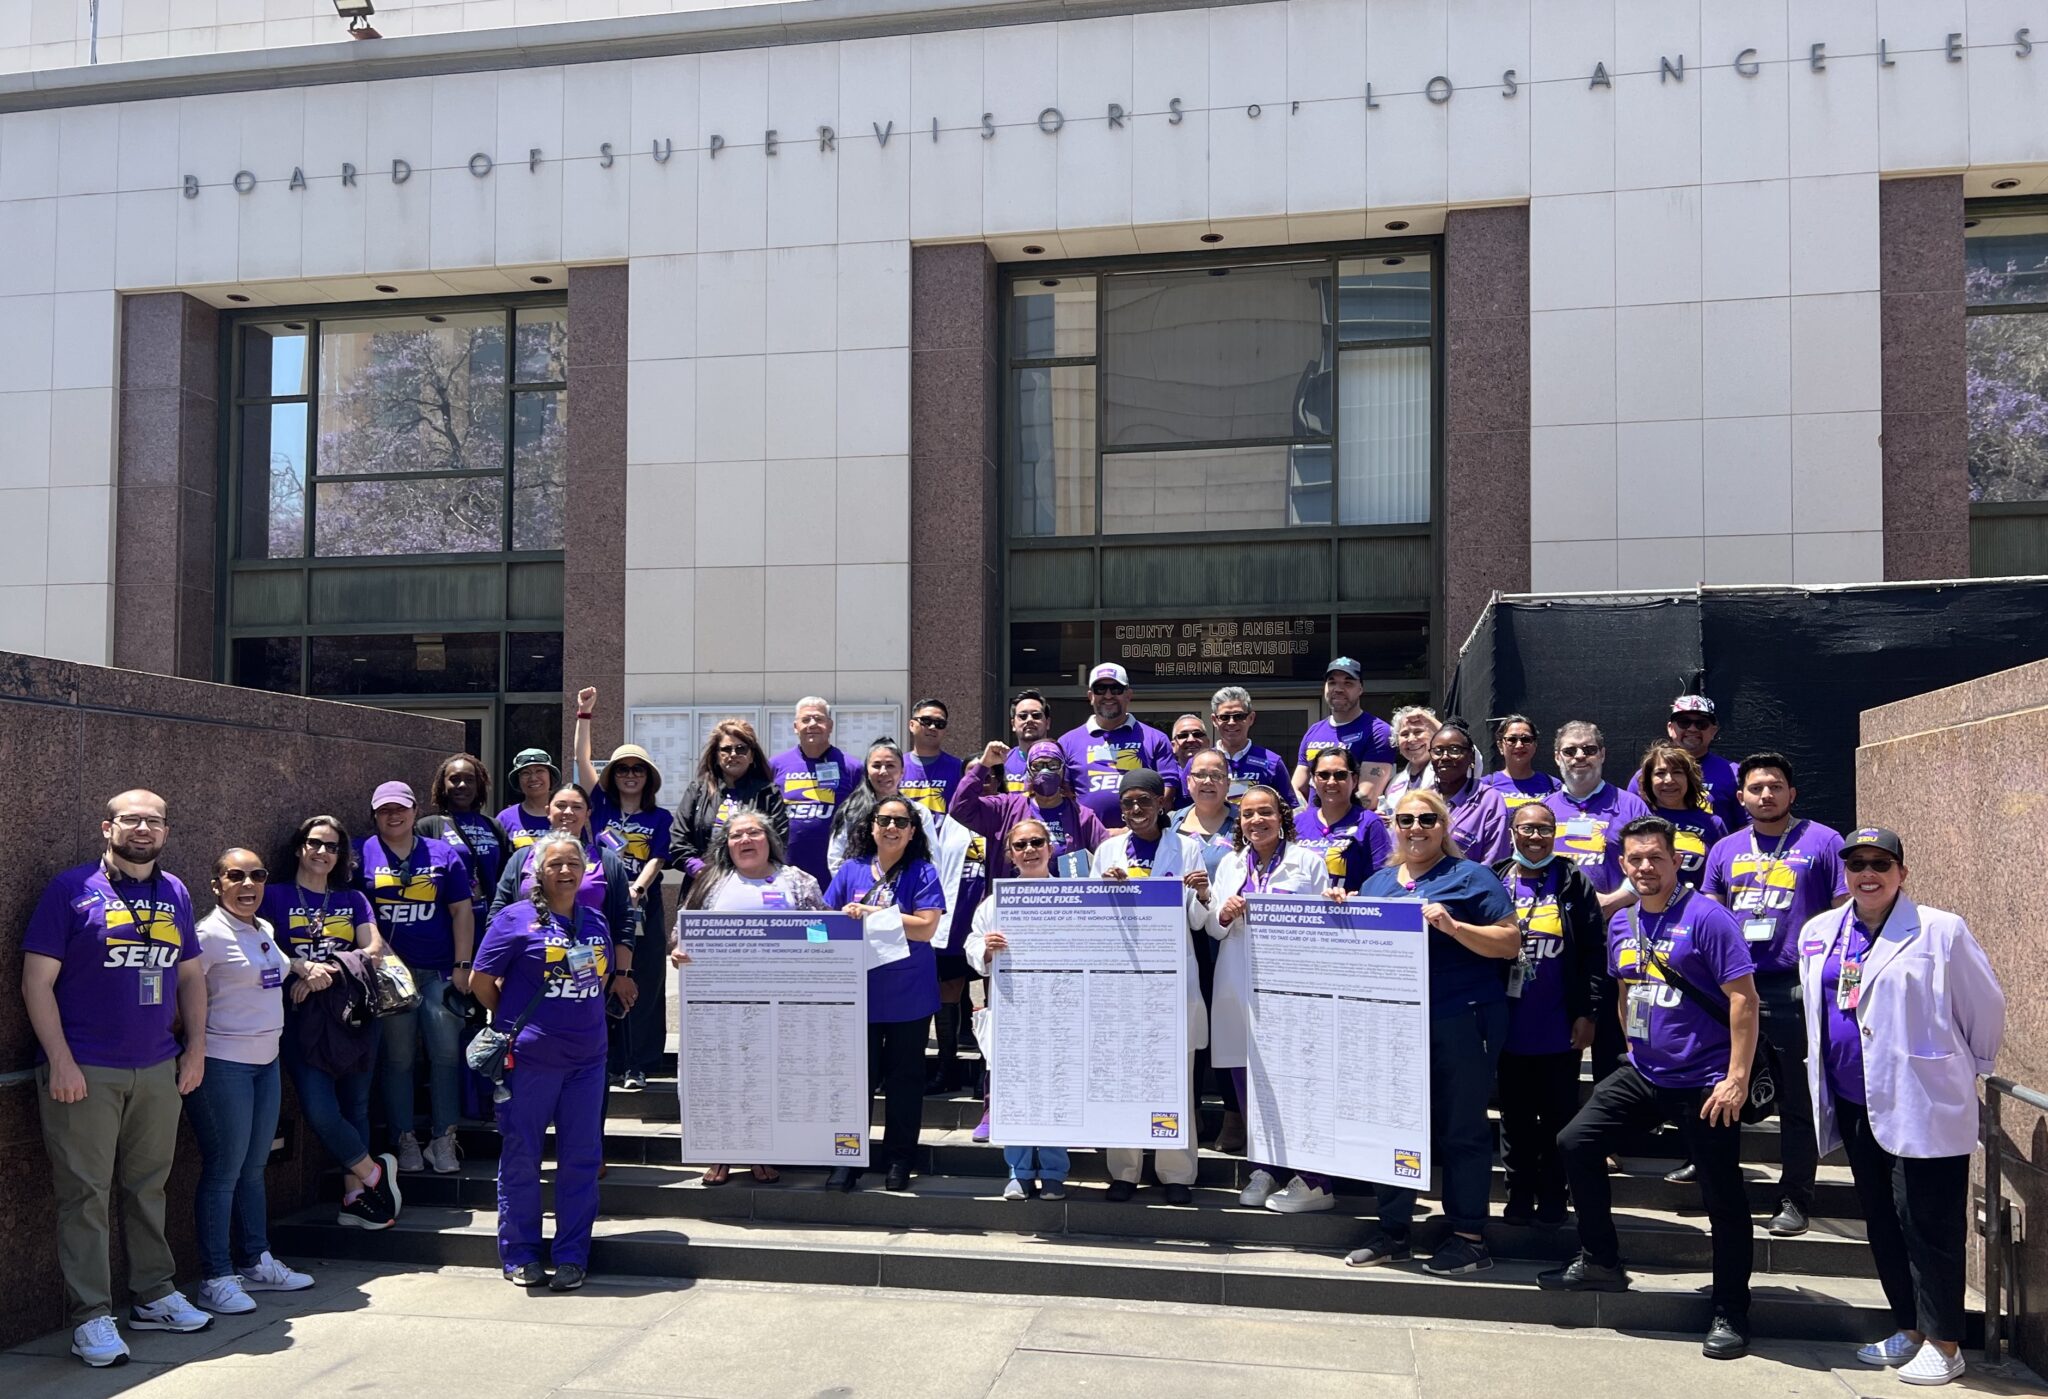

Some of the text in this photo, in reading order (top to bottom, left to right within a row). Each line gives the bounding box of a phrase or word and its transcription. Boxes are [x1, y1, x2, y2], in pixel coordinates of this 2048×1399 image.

[182, 27, 2033, 200] BOARD OF SUPERVISORS OF LOS ANGELES
[1115, 620, 1315, 640] COUNTY OF LOS ANGELES
[1121, 640, 1309, 658] BOARD OF SUPERVISORS
[1155, 660, 1275, 676] HEARING ROOM
[785, 771, 817, 780] LOCAL
[1242, 772, 1260, 780] 721
[899, 780, 930, 788] LOCAL
[1089, 774, 1124, 793] SEI
[1577, 852, 1605, 866] 721
[1000, 885, 1143, 895] WE DEMAND REAL SOLUTIONS,
[1000, 895, 1083, 904] NOT QUICK FIXES.
[155, 901, 176, 913] 721
[334, 907, 354, 916] 721
[379, 903, 436, 923] SEIU
[1249, 903, 1383, 918] WE DEMAND REAL SOLUTIONS,
[684, 919, 701, 927] WE
[701, 919, 745, 927] DEMAND
[745, 919, 769, 927] REAL
[1249, 913, 1326, 925] NOT QUICK FIXES.
[684, 928, 767, 937] NOT QUICK FIXES.
[1525, 939, 1565, 959] EIU
[1654, 939, 1675, 952] 721
[103, 946, 180, 968] SEIU
[1152, 1129, 1177, 1137] SEIU
[1396, 1167, 1420, 1177] SEIU
